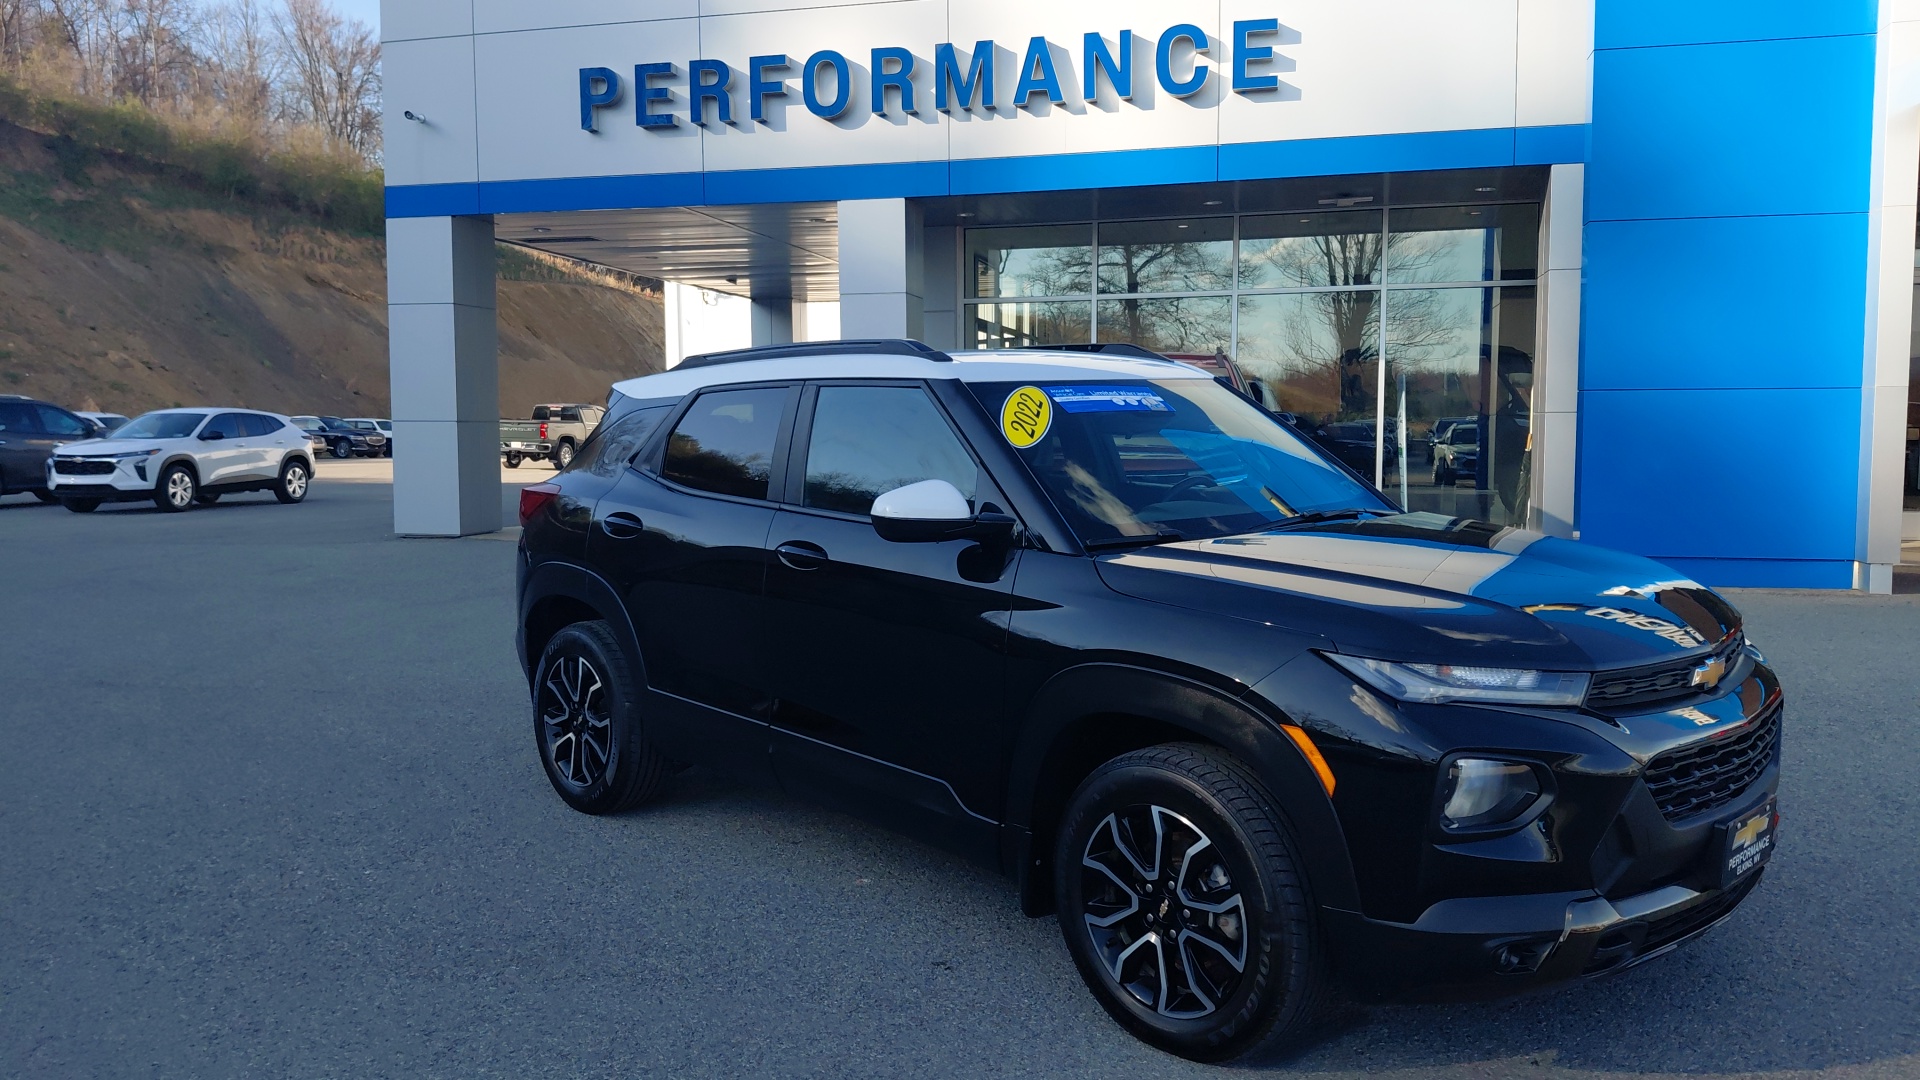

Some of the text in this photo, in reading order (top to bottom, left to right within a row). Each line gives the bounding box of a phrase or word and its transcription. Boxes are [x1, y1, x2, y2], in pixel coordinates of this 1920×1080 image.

[579, 18, 1279, 133] PERFORMANCE
[1011, 393, 1043, 439] 2022
[1728, 834, 1770, 871] PERFORMANCE
